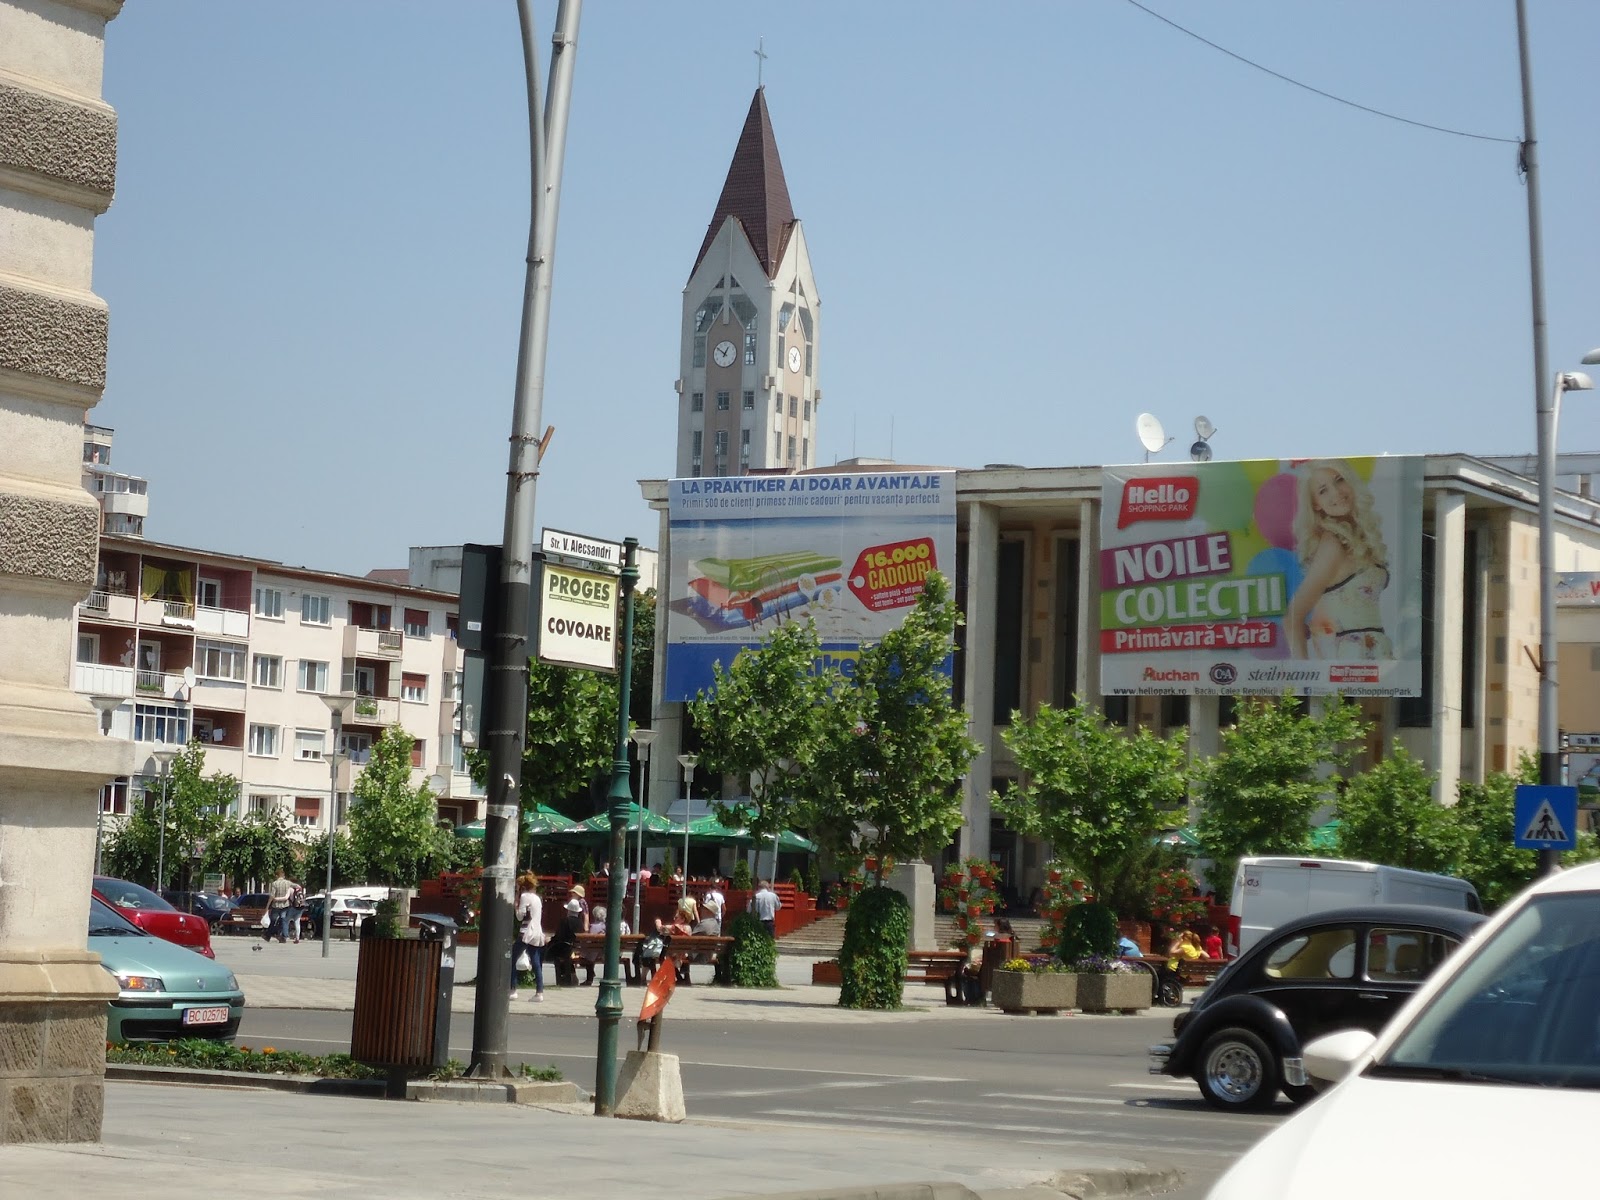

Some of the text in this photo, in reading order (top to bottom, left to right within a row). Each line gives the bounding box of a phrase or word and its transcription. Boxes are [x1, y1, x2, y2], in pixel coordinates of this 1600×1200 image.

[681, 475, 940, 494] LA PRAKTIKER AI DOAR AVANTAJE
[1128, 484, 1190, 504] Hello
[682, 498, 704, 508] Primii
[705, 498, 718, 508] 500
[720, 497, 729, 508] de
[756, 496, 786, 508] primesc
[787, 495, 809, 506] zilnic
[844, 494, 870, 506] pentru
[1128, 503, 1189, 513] SHOPPING PARK
[550, 537, 612, 560] Str. V. Alecsandri
[864, 543, 930, 569] 16.000
[1114, 535, 1231, 585] NOILE
[868, 559, 932, 590] CADOURI
[549, 574, 610, 602] PROGES
[547, 616, 611, 643] COVOARE
[1115, 622, 1271, 649] Primăvară-Vară
[1142, 666, 1200, 682] Auchan
[1247, 666, 1321, 681] steilmann
[1113, 686, 1187, 696] www.hellopark.ro
[1337, 687, 1412, 697] HelloShoppingPark
[189, 1010, 201, 1022] BC
